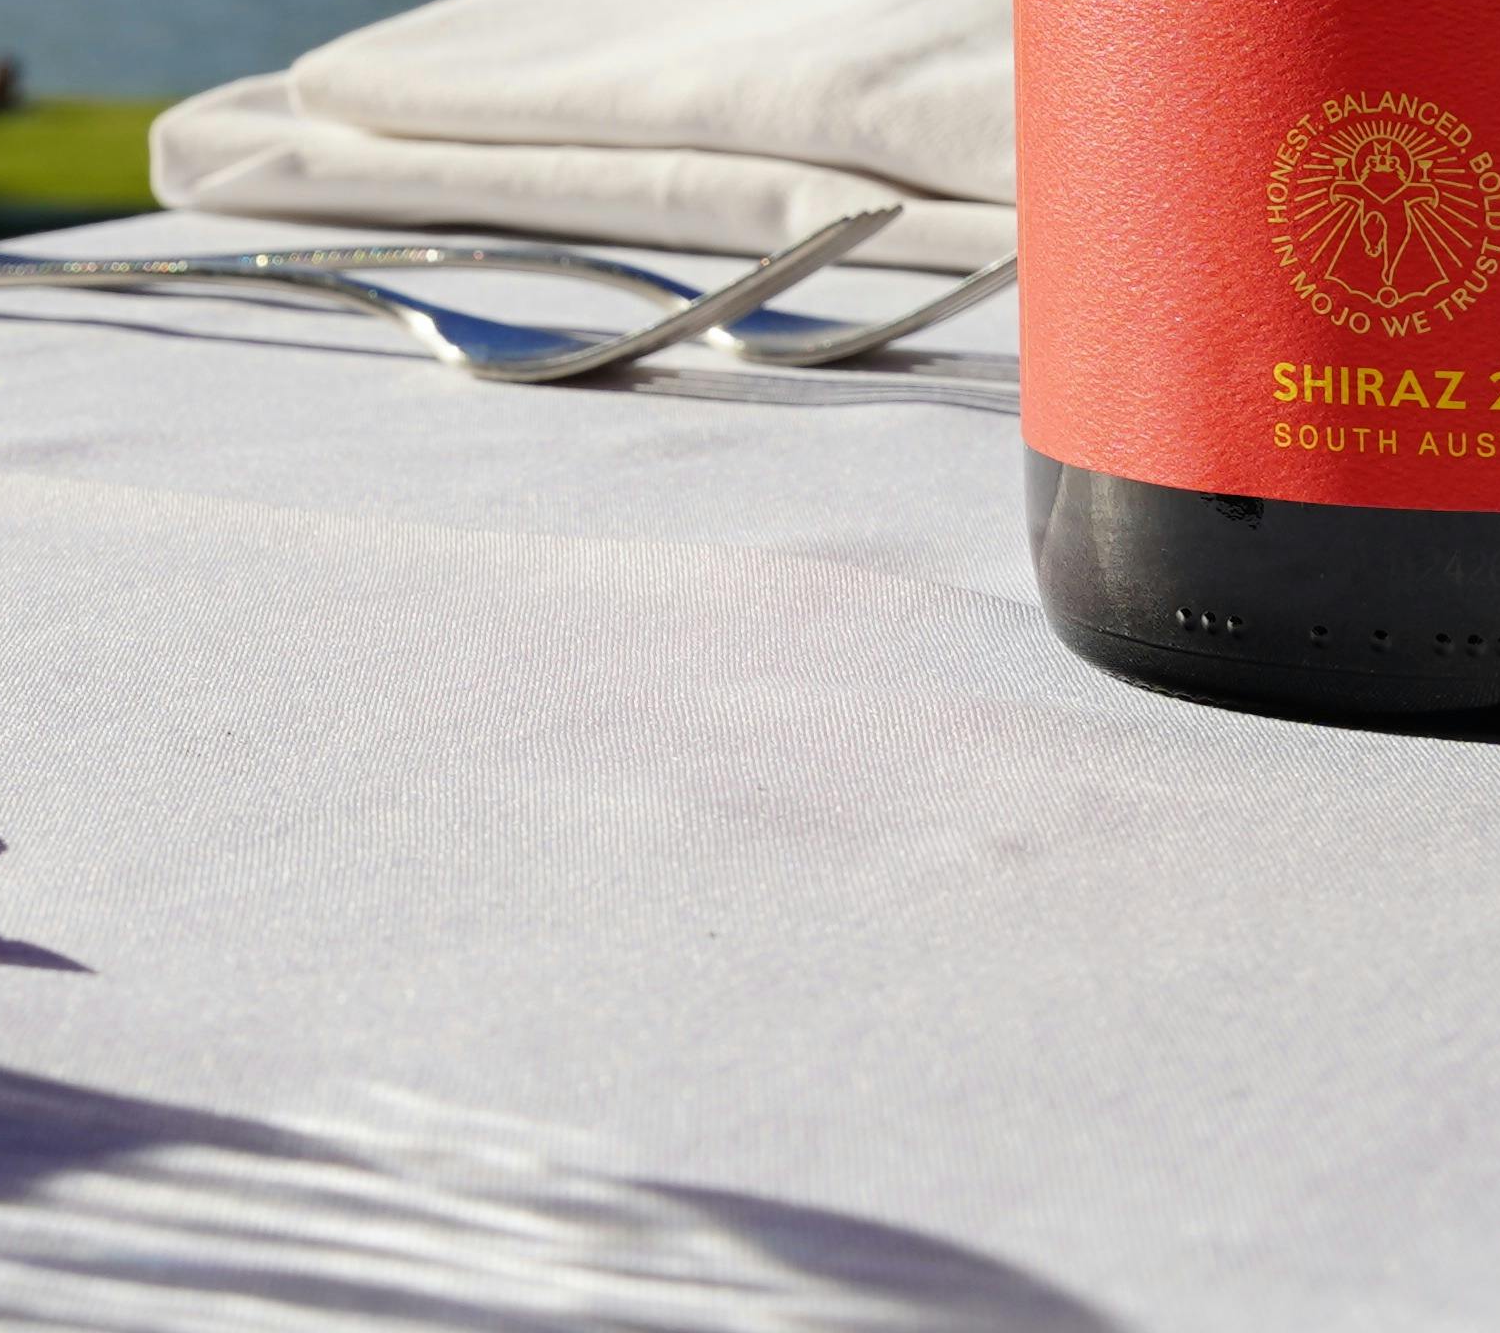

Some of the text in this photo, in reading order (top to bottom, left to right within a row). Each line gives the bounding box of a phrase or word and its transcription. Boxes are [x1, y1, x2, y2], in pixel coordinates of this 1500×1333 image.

[1271, 235, 1299, 268] IN
[1289, 271, 1371, 334] MOJO
[1380, 310, 1432, 338] WE
[1272, 361, 1467, 410] SHIRAZ
[1273, 422, 1398, 455] SOUTH
